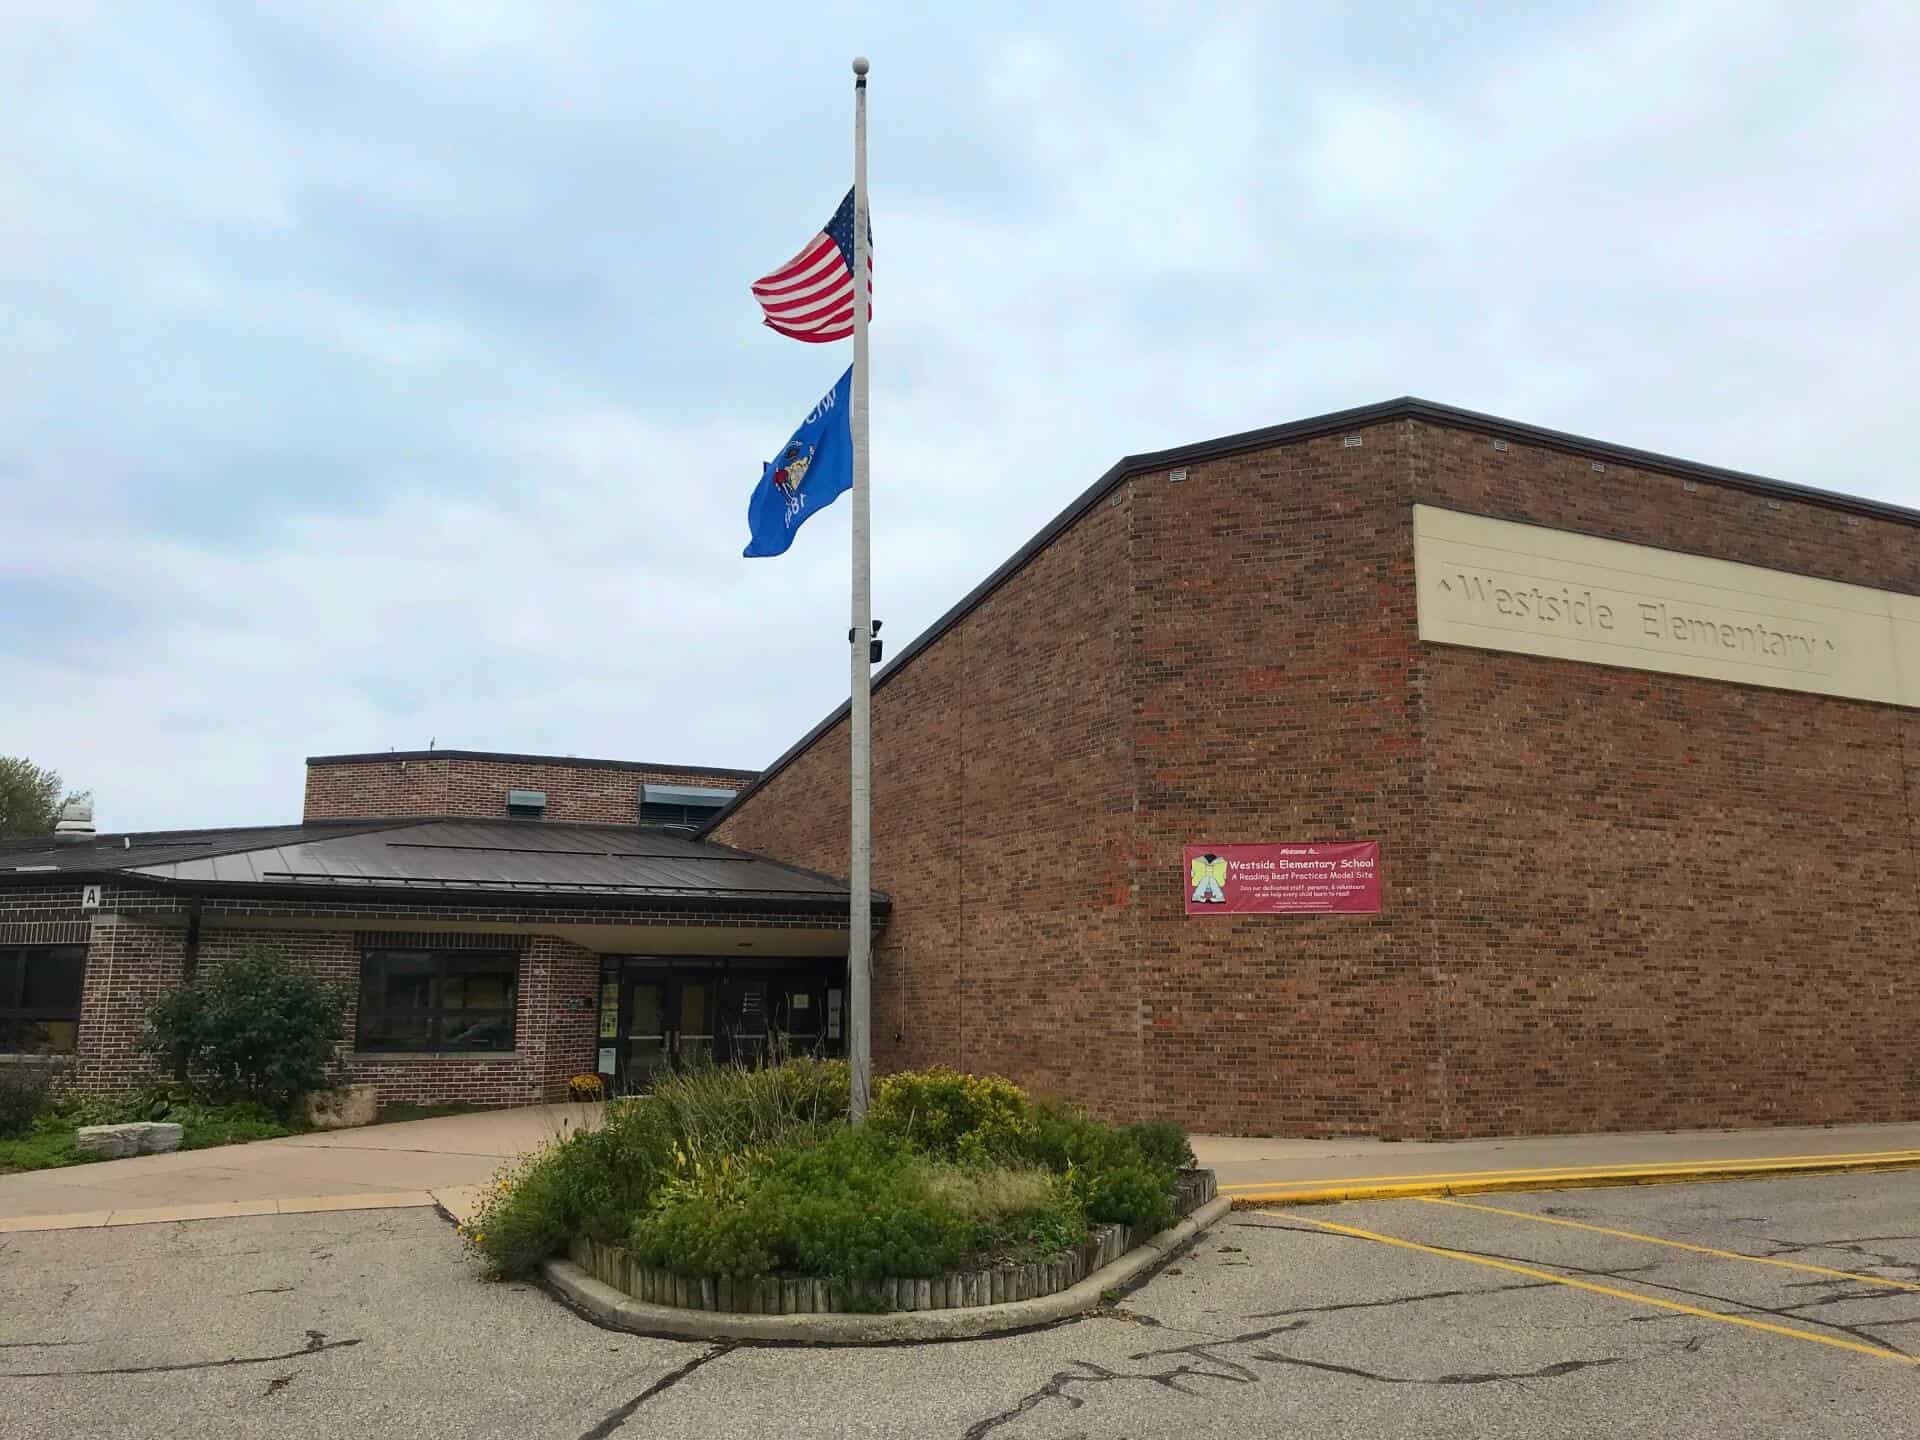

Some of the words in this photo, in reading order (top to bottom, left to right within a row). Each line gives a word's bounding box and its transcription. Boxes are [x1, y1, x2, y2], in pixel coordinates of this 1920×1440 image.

[1456, 574, 1615, 631] Westside
[1637, 602, 1817, 670] Elementary
[1229, 860, 1275, 870] Westside
[1279, 859, 1336, 871] Elementary
[1340, 857, 1374, 868] School
[1239, 872, 1270, 882] Reading
[1271, 872, 1289, 881] Best
[1290, 871, 1329, 880] Practices
[1329, 870, 1354, 879] Model
[1356, 870, 1374, 879] Site
[86, 889, 96, 905] A
